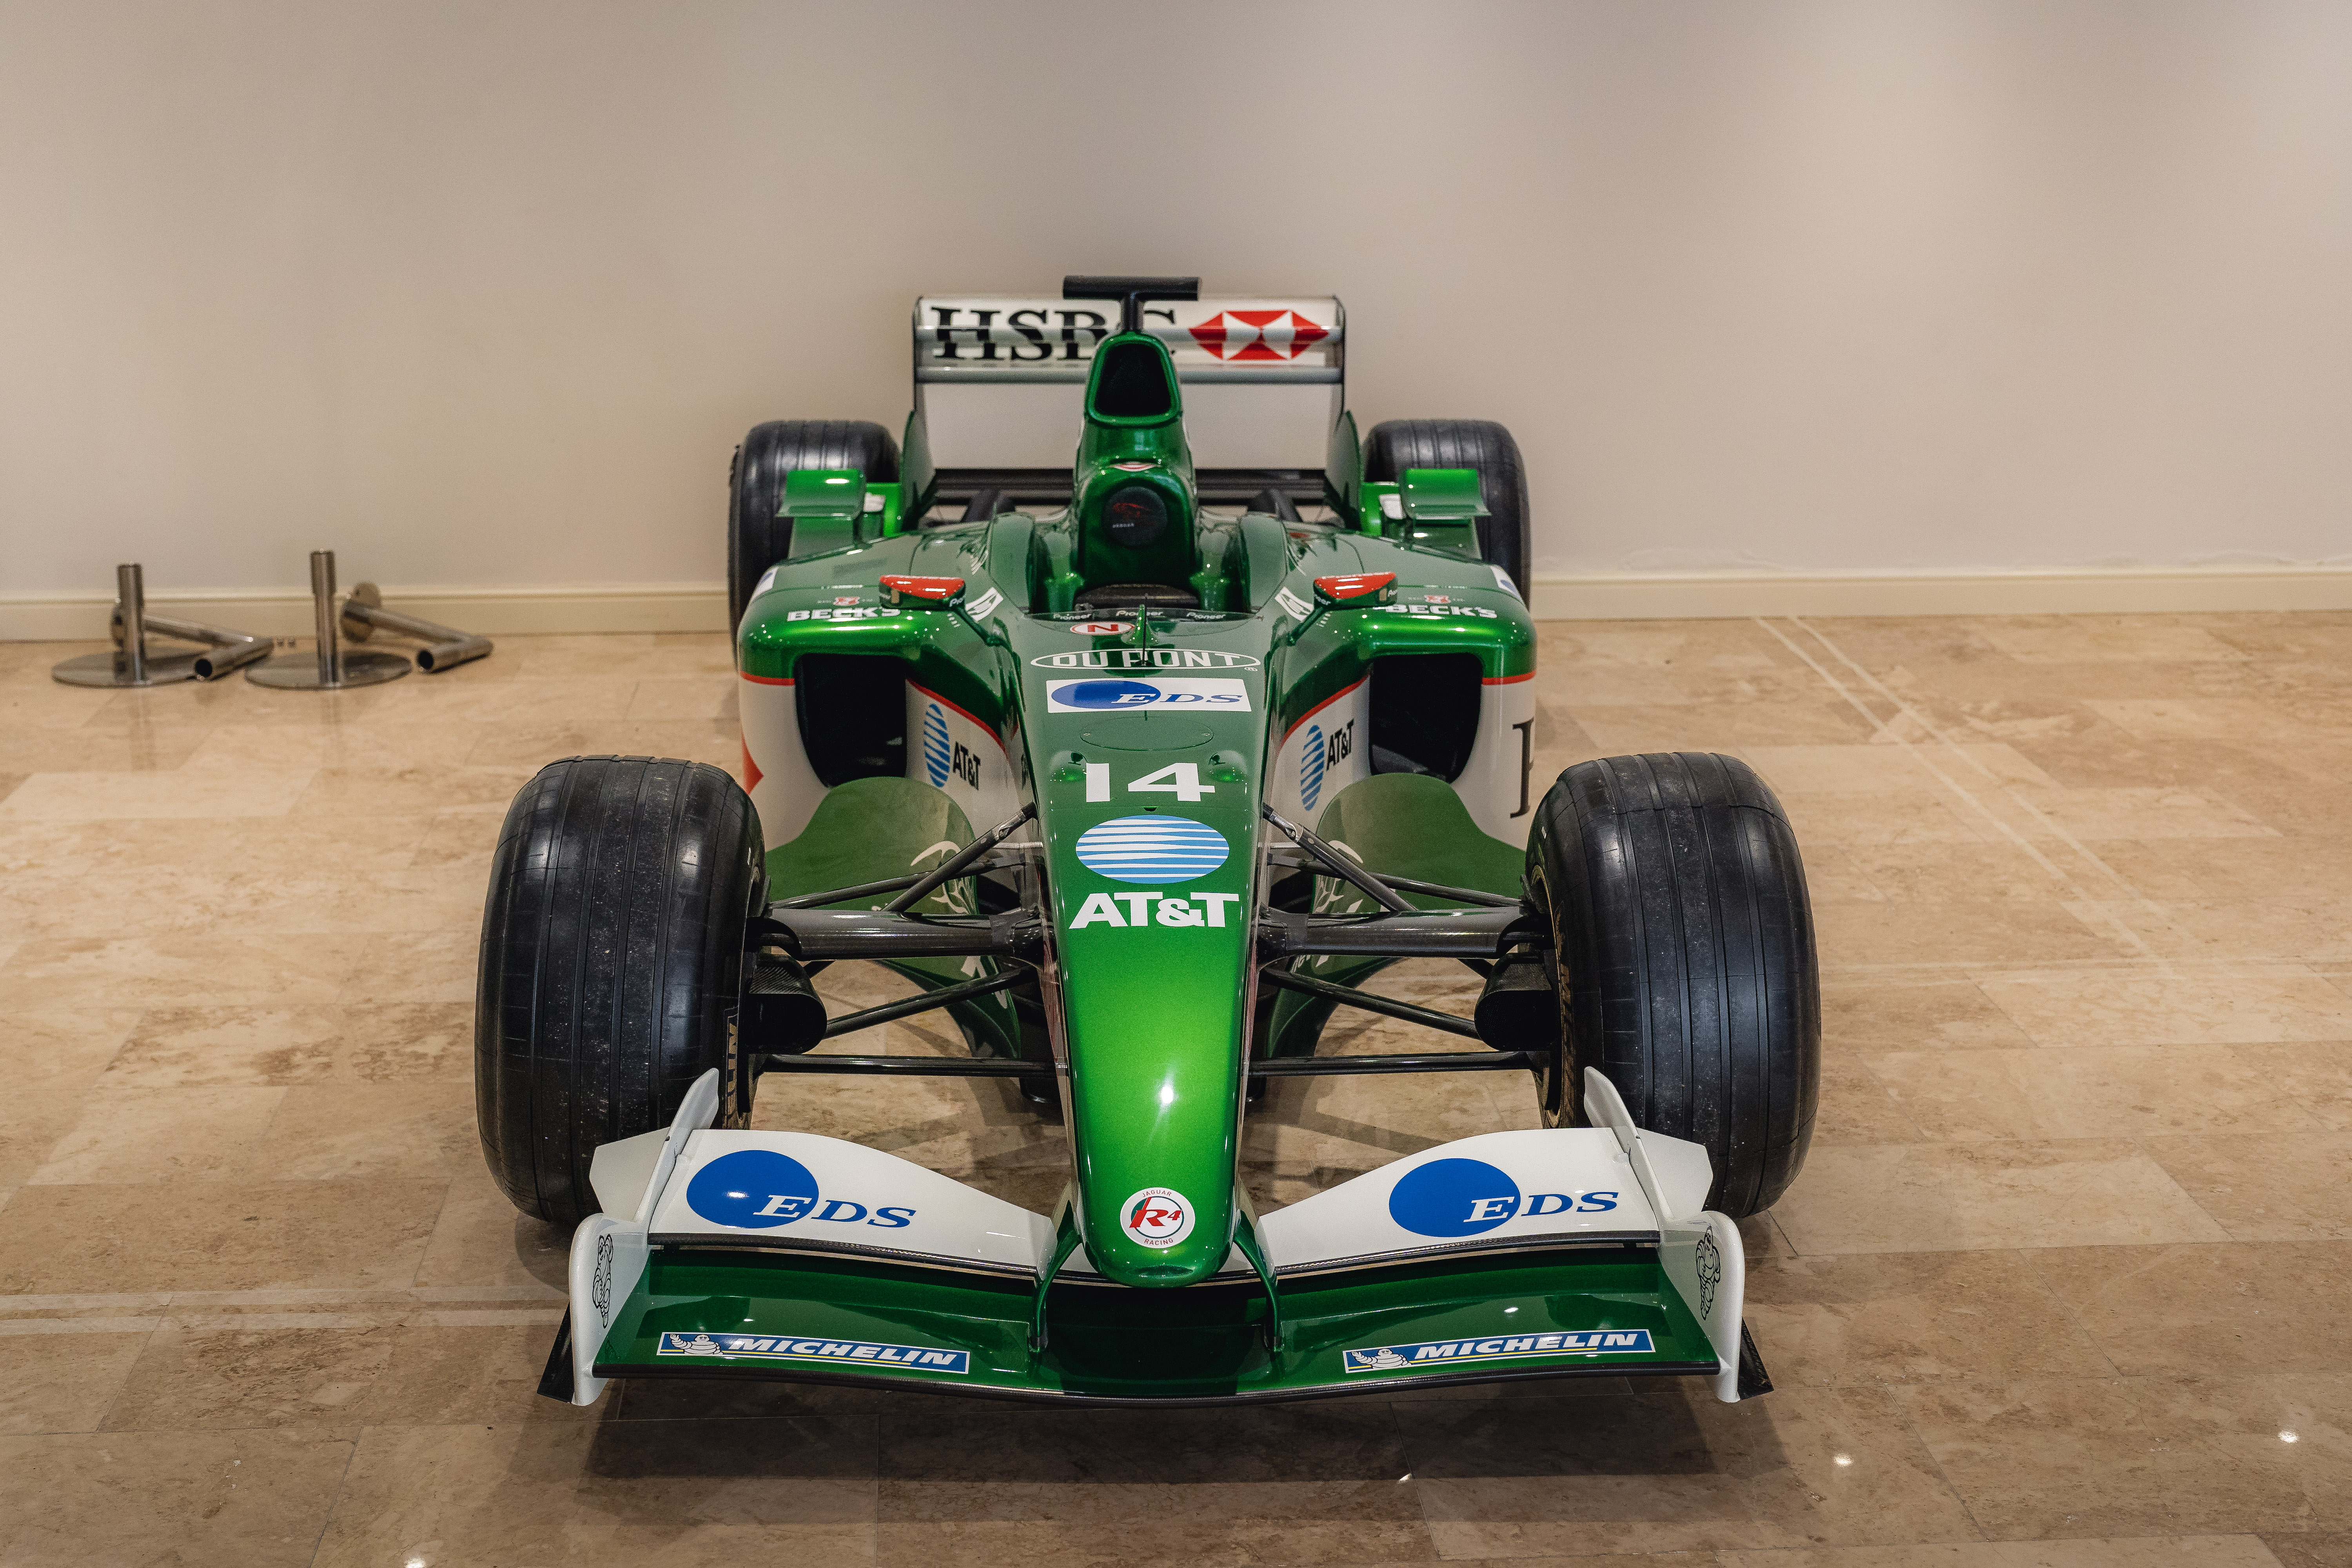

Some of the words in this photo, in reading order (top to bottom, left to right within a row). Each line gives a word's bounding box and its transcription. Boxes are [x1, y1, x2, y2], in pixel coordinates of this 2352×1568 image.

[931, 306, 1175, 360] HSB
[1053, 651, 1109, 667] DU
[1121, 650, 1240, 667] PONT
[1111, 693, 1242, 703] EDS
[1327, 718, 1354, 771] AT&T
[953, 741, 981, 791] AT&T
[1086, 763, 1215, 802] 14
[1069, 891, 1239, 929] AT&T
[753, 1194, 917, 1228] EDS
[1463, 1192, 1619, 1223] EDS
[729, 1338, 958, 1365] MICHELIN
[1414, 1334, 1638, 1359] MICHELIN
